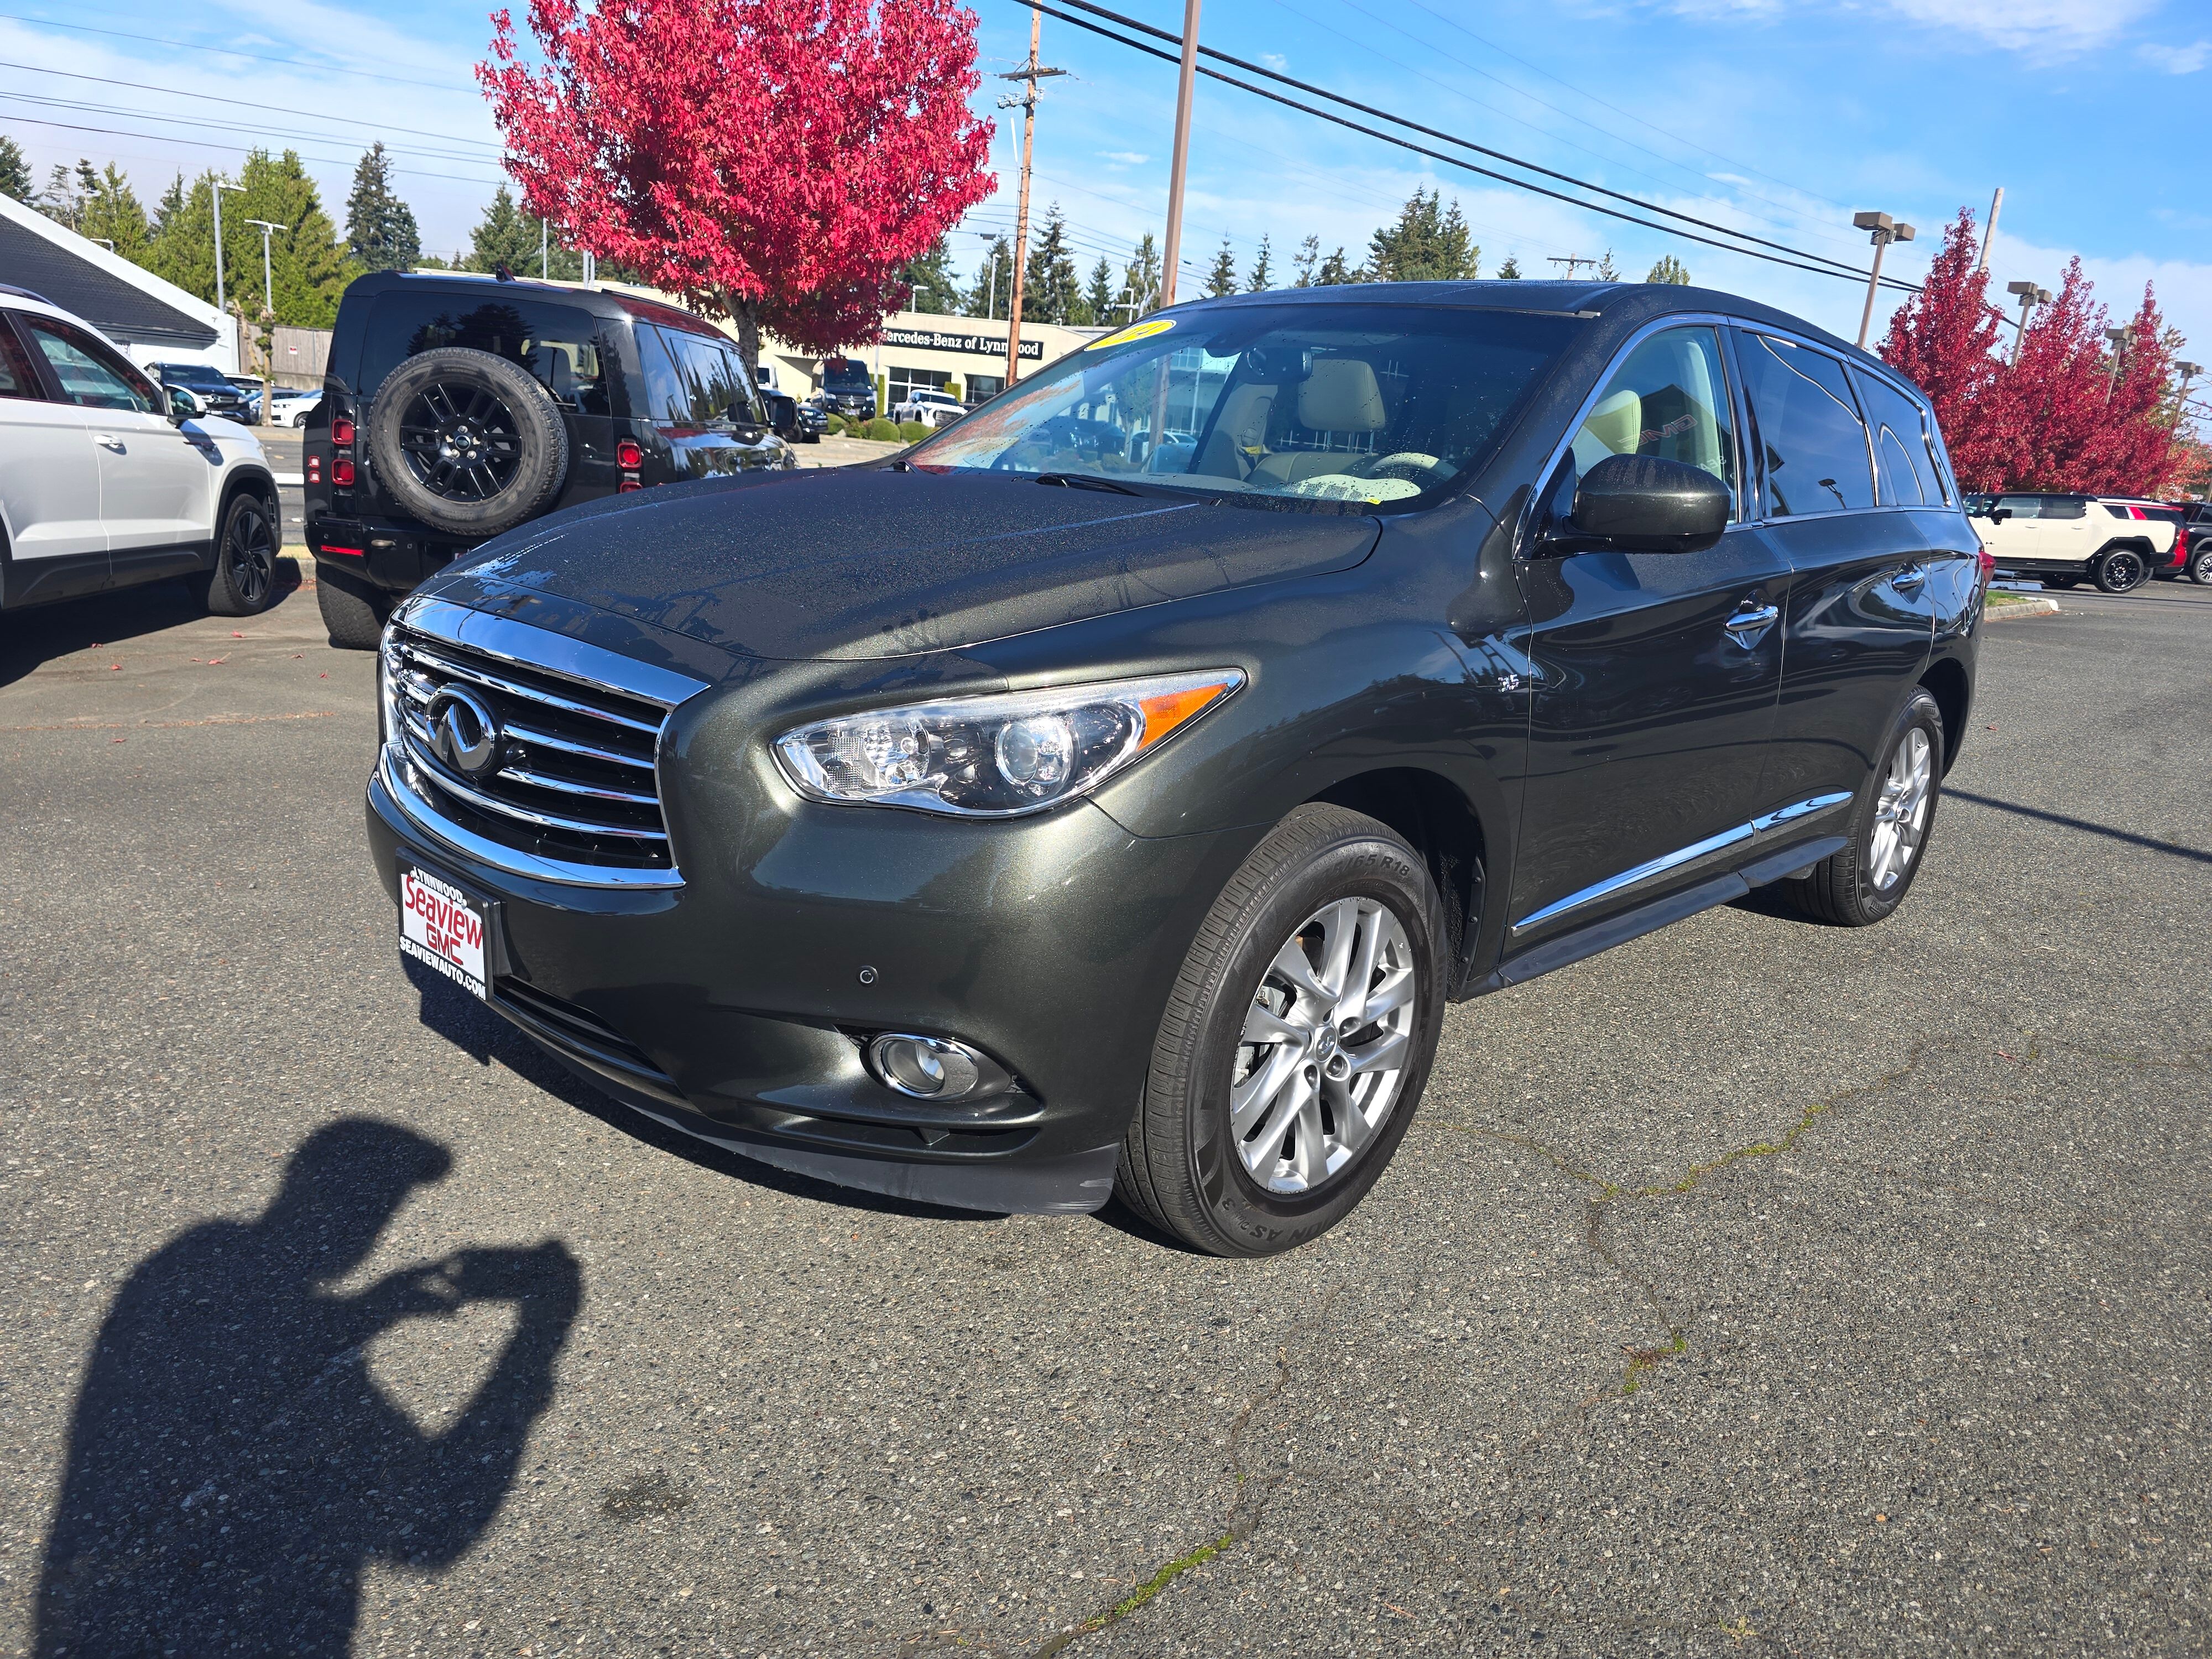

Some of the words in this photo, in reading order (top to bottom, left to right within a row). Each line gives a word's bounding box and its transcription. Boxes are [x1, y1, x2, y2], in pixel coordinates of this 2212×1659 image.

[964, 336, 978, 349] of
[979, 337, 1039, 356] Lynnood
[1379, 855, 1410, 877] R18
[413, 865, 463, 902] LYNNWOOD
[405, 875, 483, 950] Seaview
[426, 922, 464, 966] GMC
[399, 936, 487, 1001] SEAVIEWAUTO.COM
[1221, 1197, 1236, 1211] 3
[1249, 1224, 1284, 1241] AS
